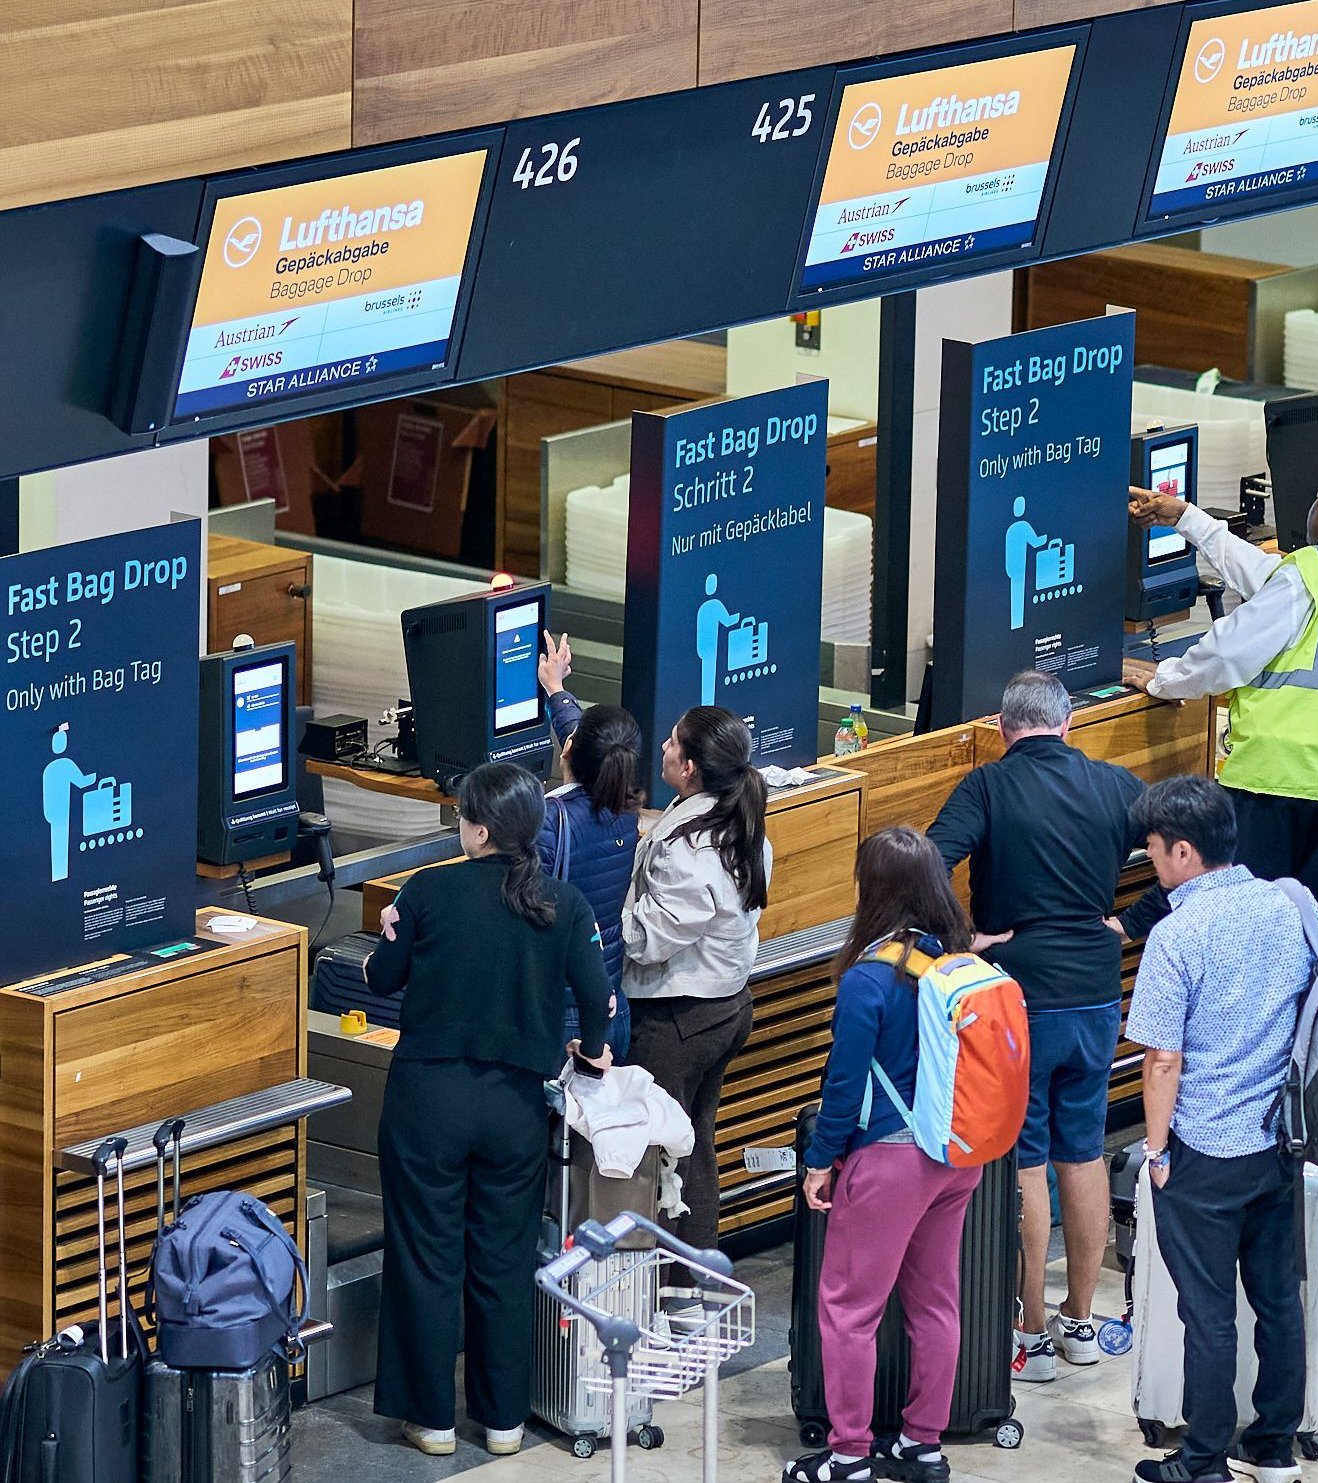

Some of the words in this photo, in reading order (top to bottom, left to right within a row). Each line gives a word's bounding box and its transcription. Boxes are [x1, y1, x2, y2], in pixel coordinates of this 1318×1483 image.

[895, 90, 1021, 136] Lufthansa
[1227, 93, 1278, 112] Baggage
[1279, 86, 1308, 103] Drop
[751, 93, 816, 144] 425
[891, 126, 990, 158] Gepäckabgabe
[1183, 133, 1231, 155] Austrian
[511, 137, 580, 190] 426
[886, 159, 942, 181] Baggage
[943, 151, 975, 171] Drop
[1201, 158, 1235, 176] SWISS
[965, 176, 1001, 195] brussels
[1205, 180, 1236, 200] STAR
[1238, 169, 1295, 193] ALLIANCE
[279, 200, 425, 252] Lufthansa
[837, 201, 891, 225] Austrian
[858, 228, 895, 247] SWISS
[863, 250, 897, 271] STAR
[898, 240, 961, 263] ALLIANCE
[275, 240, 390, 276] Gepäckabgabe
[270, 274, 334, 300] Baggage
[337, 266, 373, 287] Drop
[364, 294, 405, 312] brussels
[214, 324, 276, 349] Austrian
[240, 351, 283, 372] SWISS
[246, 374, 286, 398] STAR
[287, 360, 362, 389] ALLIANCE
[983, 360, 1023, 394] Fast
[1028, 352, 1066, 387] Bag
[1073, 341, 1123, 375] Drop
[981, 407, 1023, 438] Step
[1028, 398, 1040, 425] 2
[675, 431, 715, 468] Fast
[721, 427, 760, 460] Bag
[766, 412, 818, 445] Drop
[979, 456, 1010, 480] Only
[1012, 444, 1042, 469] with
[1046, 441, 1072, 465] Bag
[1076, 435, 1101, 458] Tag
[673, 471, 737, 513] Schritt
[742, 465, 754, 494] 2
[671, 533, 695, 556] Nur
[699, 525, 723, 546] mit
[726, 501, 812, 542] Gepäcklabel
[7, 578, 59, 616] Fast
[66, 567, 115, 605] Bag
[124, 552, 188, 592] Drop
[6, 627, 60, 664] Step
[67, 618, 82, 650] 2
[6, 683, 44, 711] Only
[50, 672, 87, 702] with
[92, 666, 126, 696] Bag
[132, 657, 162, 684] Tag
